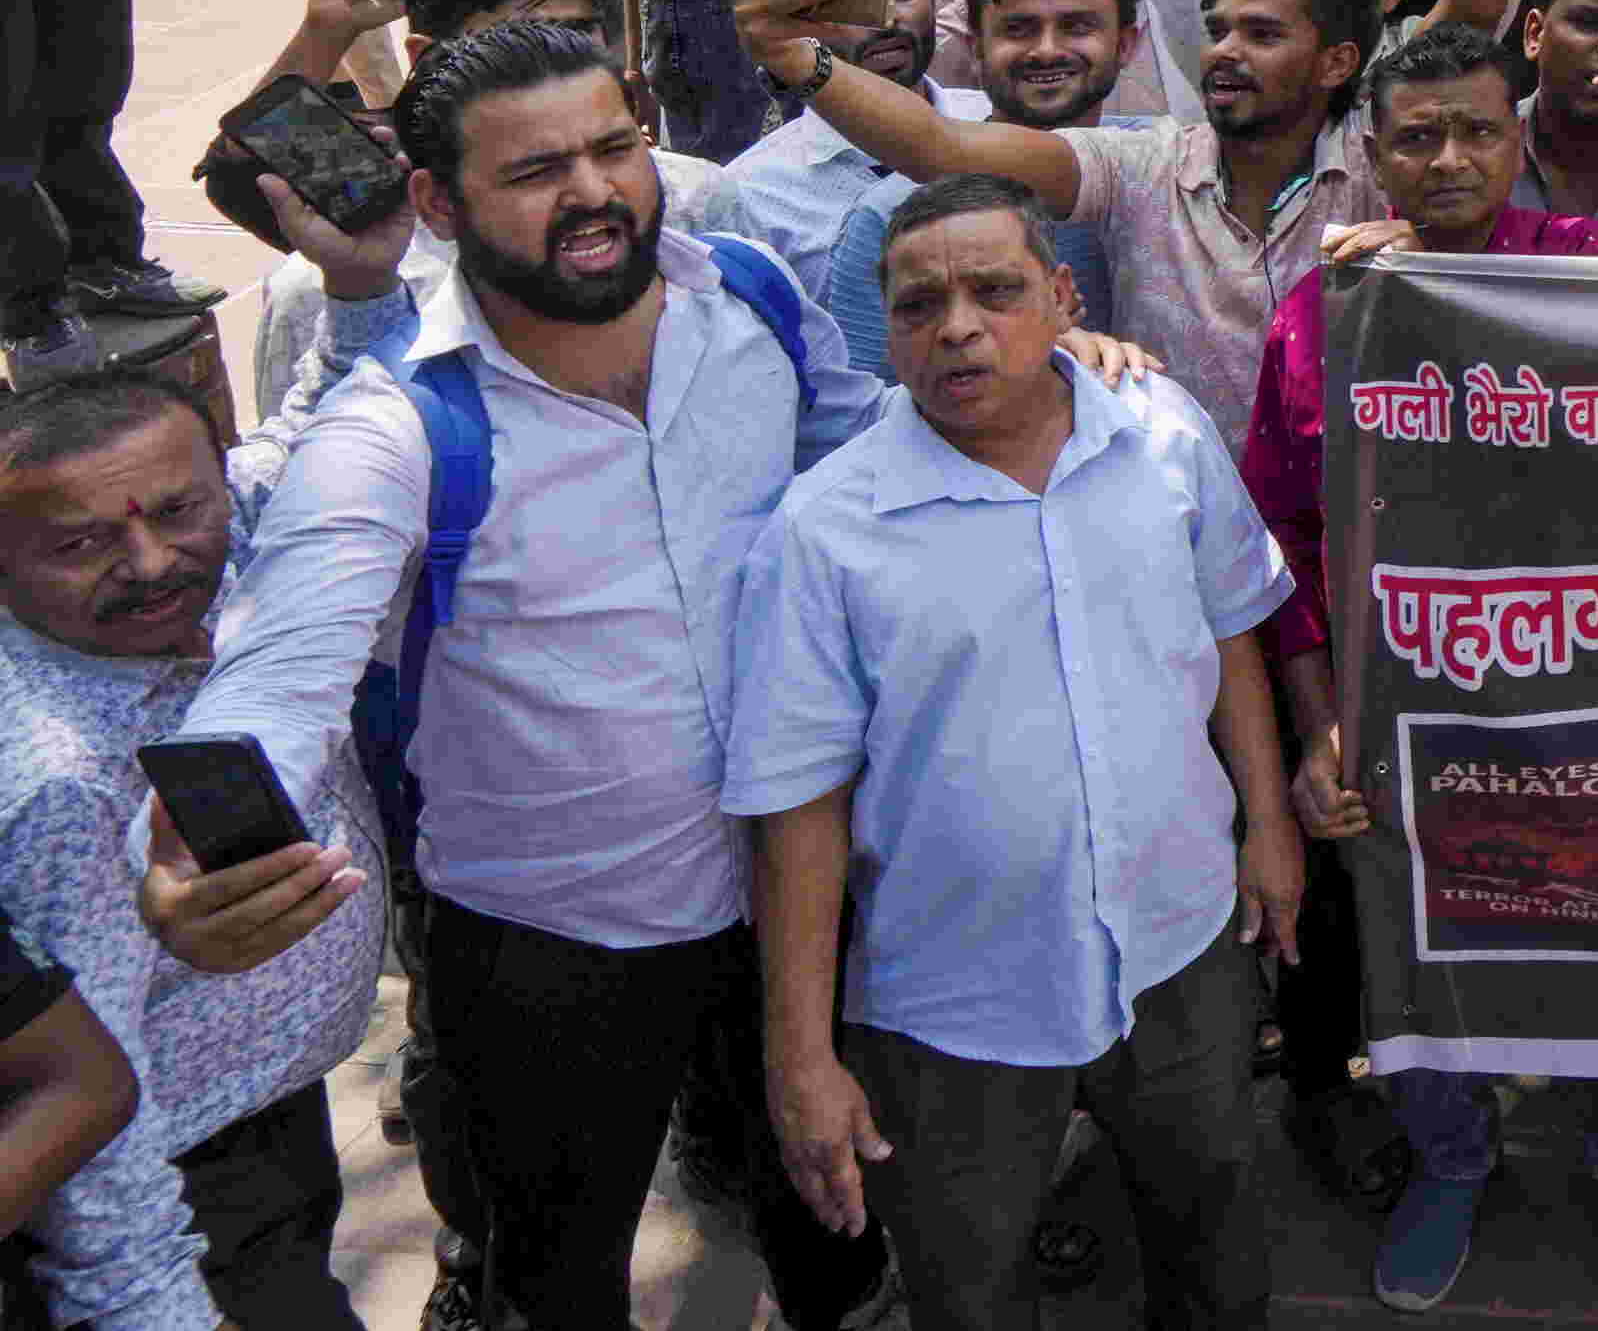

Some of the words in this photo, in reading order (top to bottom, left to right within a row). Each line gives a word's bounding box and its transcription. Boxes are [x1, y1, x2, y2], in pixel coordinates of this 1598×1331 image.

[1352, 361, 1452, 442] गली
[1464, 362, 1554, 448] भैरो
[1441, 762, 1509, 778] ALL
[1439, 888, 1553, 906] TERROR
[1488, 901, 1529, 915] ON
